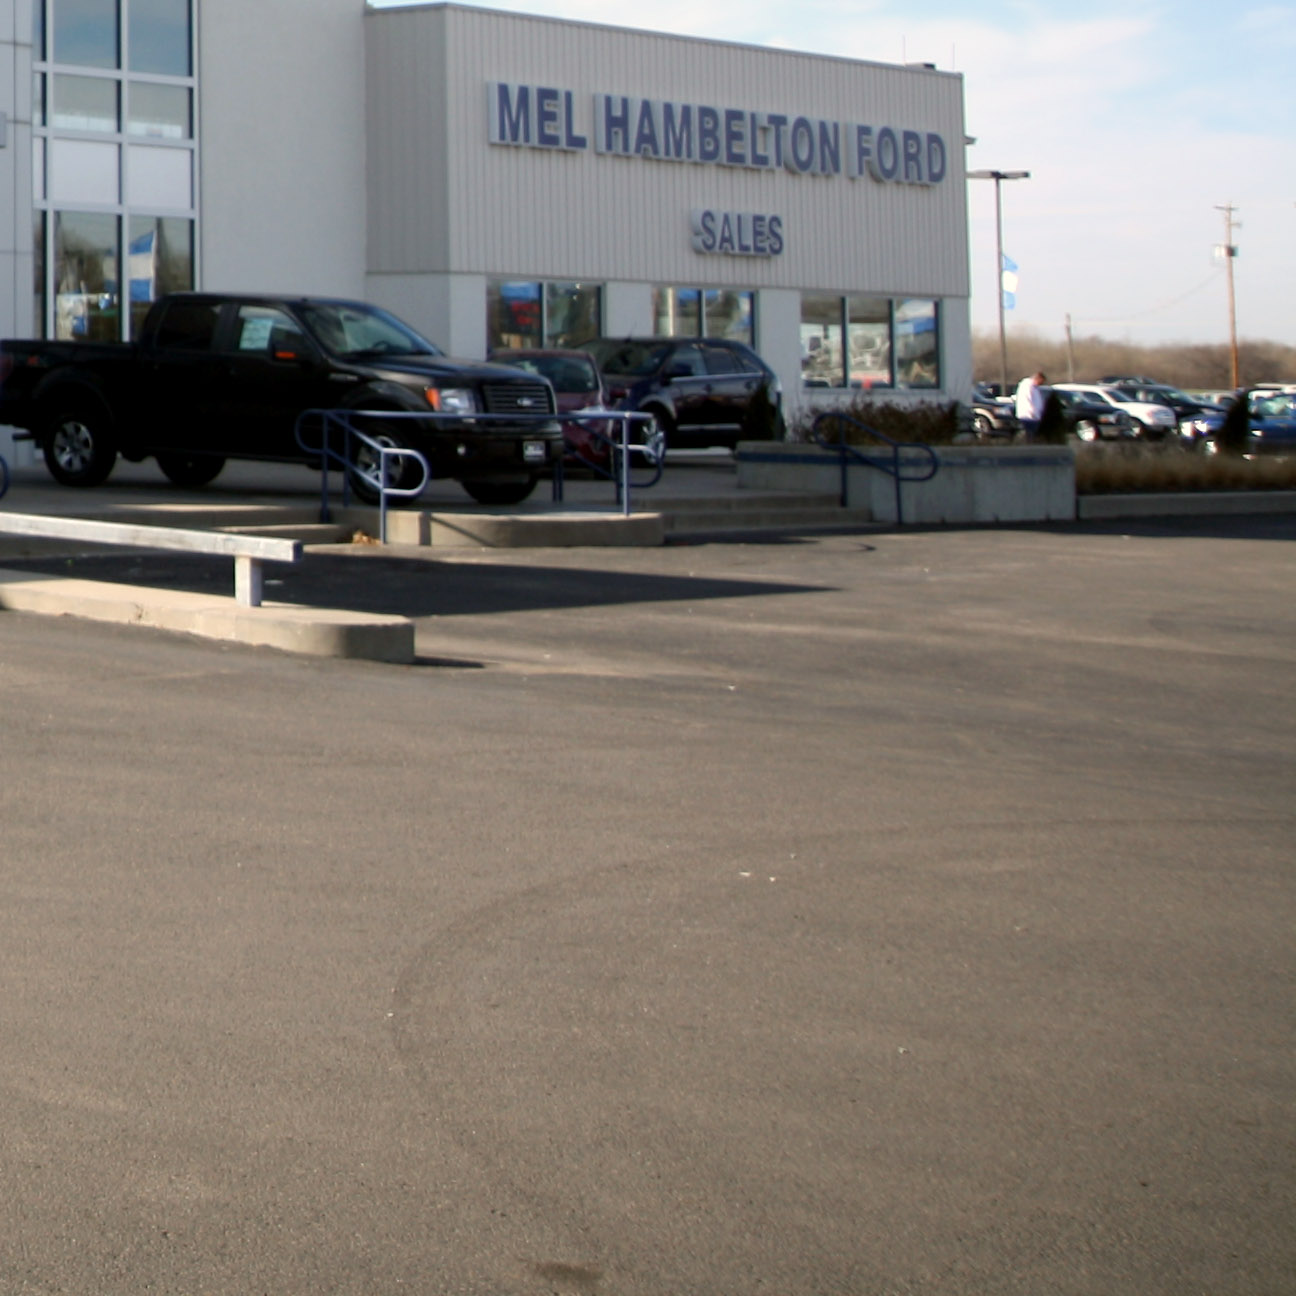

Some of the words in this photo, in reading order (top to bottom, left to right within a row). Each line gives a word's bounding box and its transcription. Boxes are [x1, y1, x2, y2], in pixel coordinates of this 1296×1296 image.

[492, 82, 587, 150] MEL
[599, 93, 841, 175] HAMBELTON
[852, 123, 947, 185] FORD
[695, 209, 784, 256] SALES
